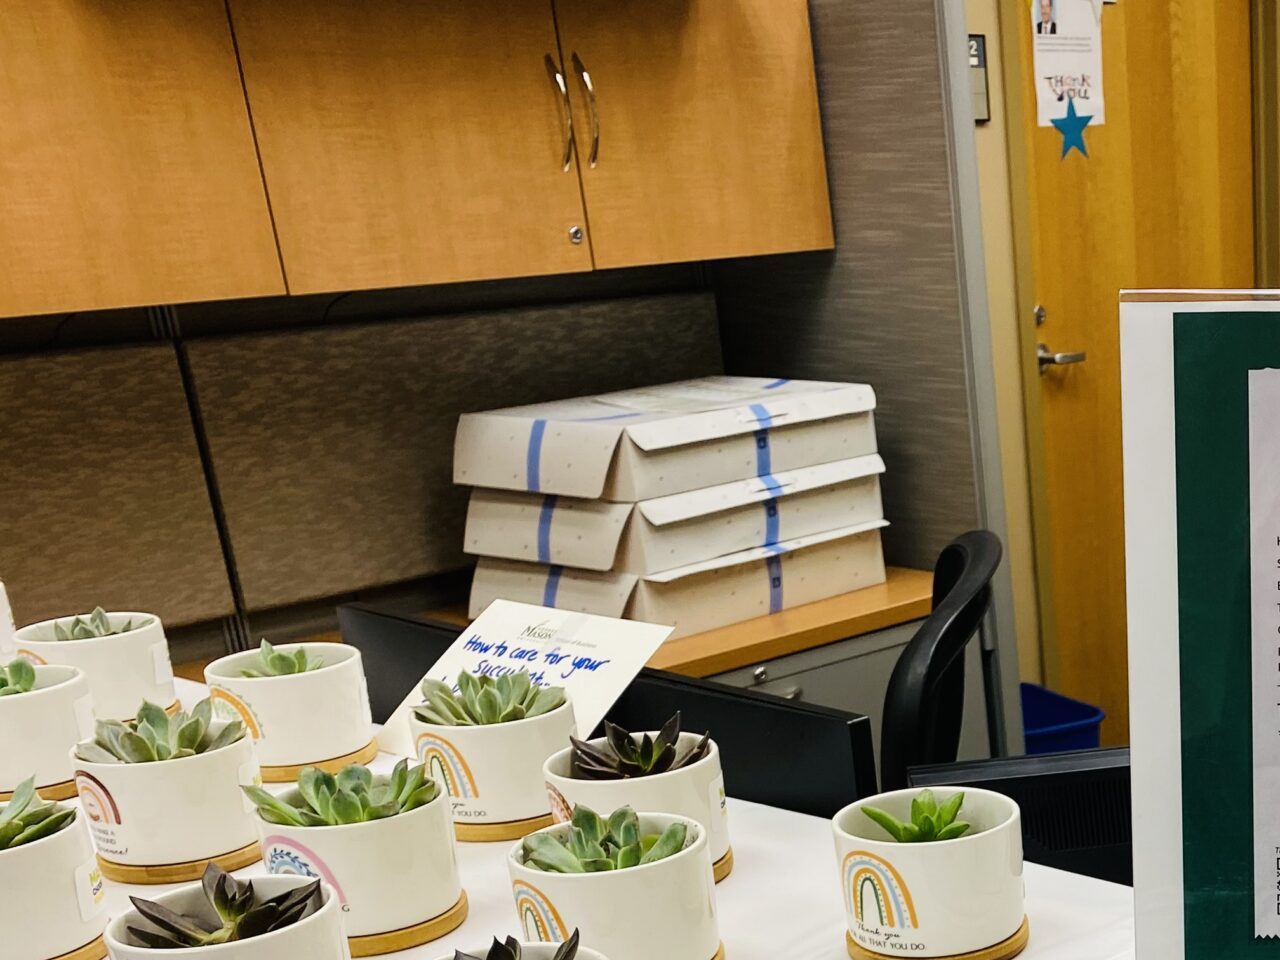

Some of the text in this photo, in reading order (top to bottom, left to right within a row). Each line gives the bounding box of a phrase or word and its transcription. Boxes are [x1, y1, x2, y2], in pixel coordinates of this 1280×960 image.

[464, 635, 610, 679] How to care for your
[869, 939, 887, 948] THAT
[890, 942, 907, 950] YOU
